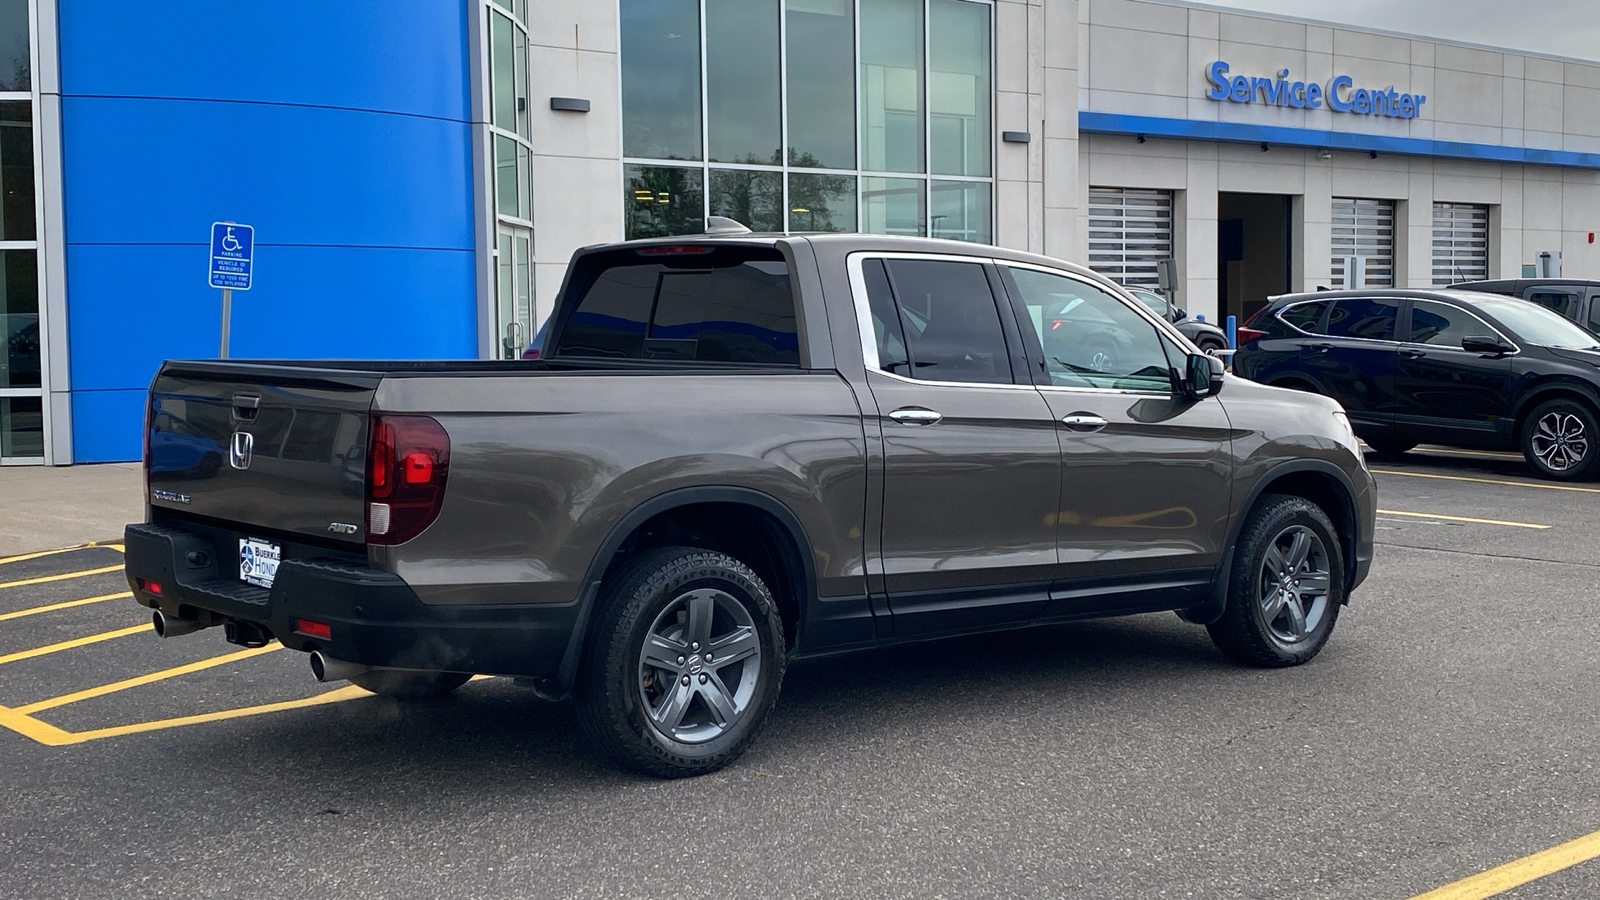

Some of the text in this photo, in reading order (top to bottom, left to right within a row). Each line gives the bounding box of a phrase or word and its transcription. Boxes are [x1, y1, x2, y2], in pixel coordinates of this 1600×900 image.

[1206, 61, 1426, 118] Service Center
[327, 522, 357, 534] AWD
[255, 557, 275, 576] HOND
